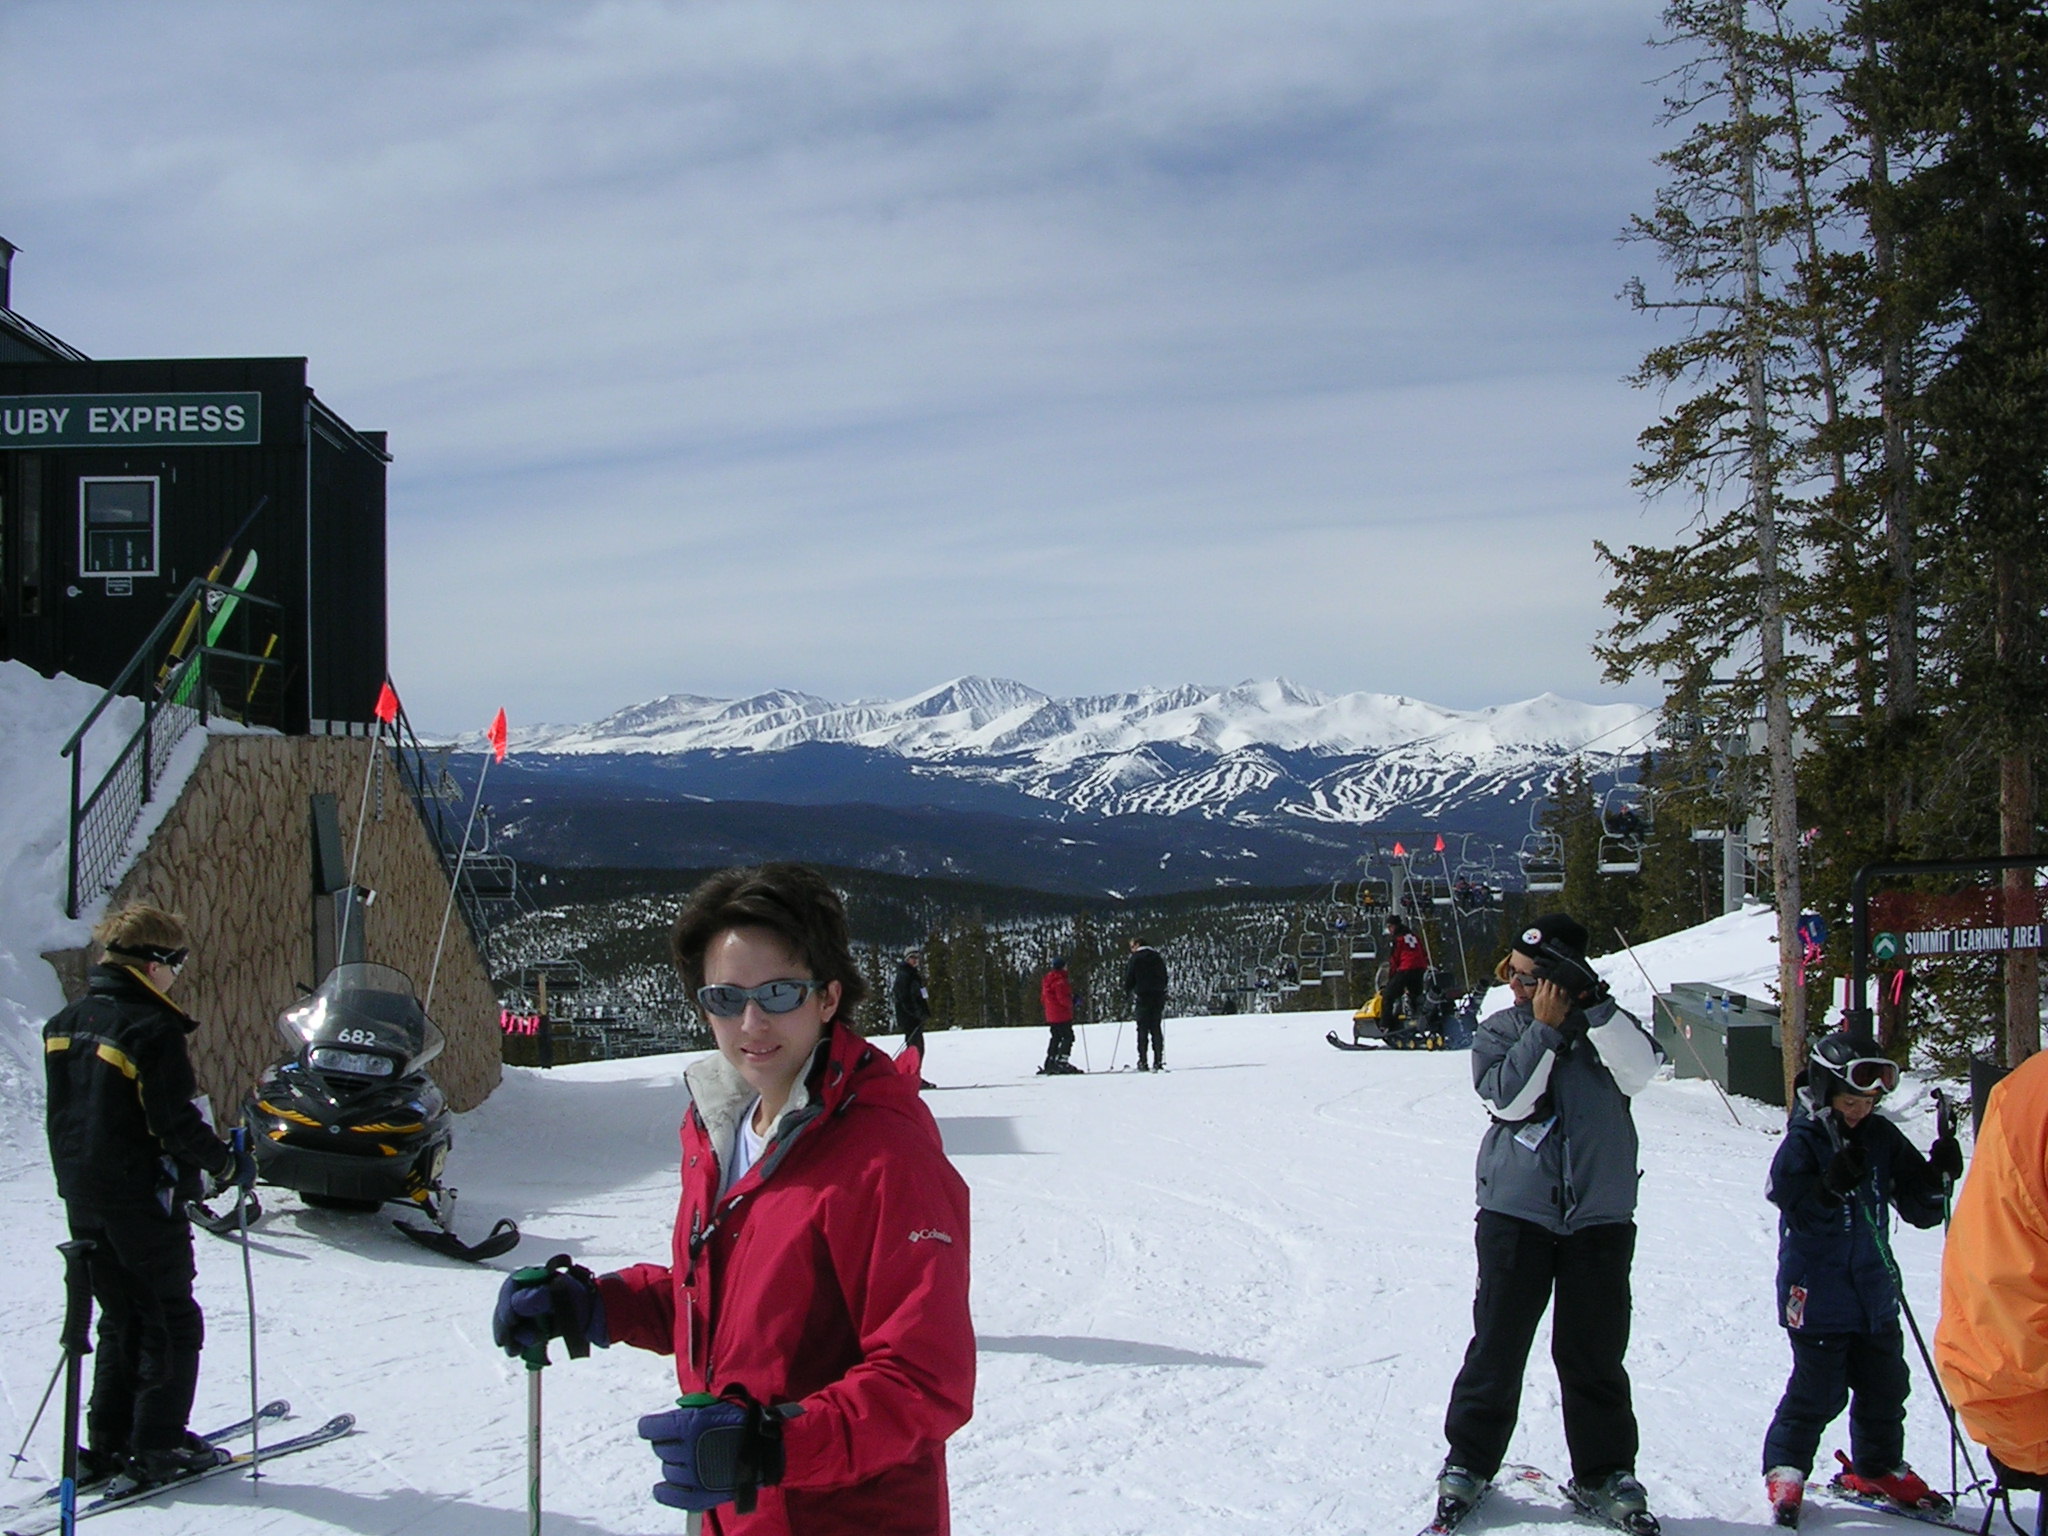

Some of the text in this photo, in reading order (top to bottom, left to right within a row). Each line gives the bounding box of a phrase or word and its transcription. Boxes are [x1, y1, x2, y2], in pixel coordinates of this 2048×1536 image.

[0, 405, 246, 435] UBY EXPRESS
[1904, 925, 2042, 955] SUMMIT LEARNING AREA
[338, 1028, 376, 1047] 682
